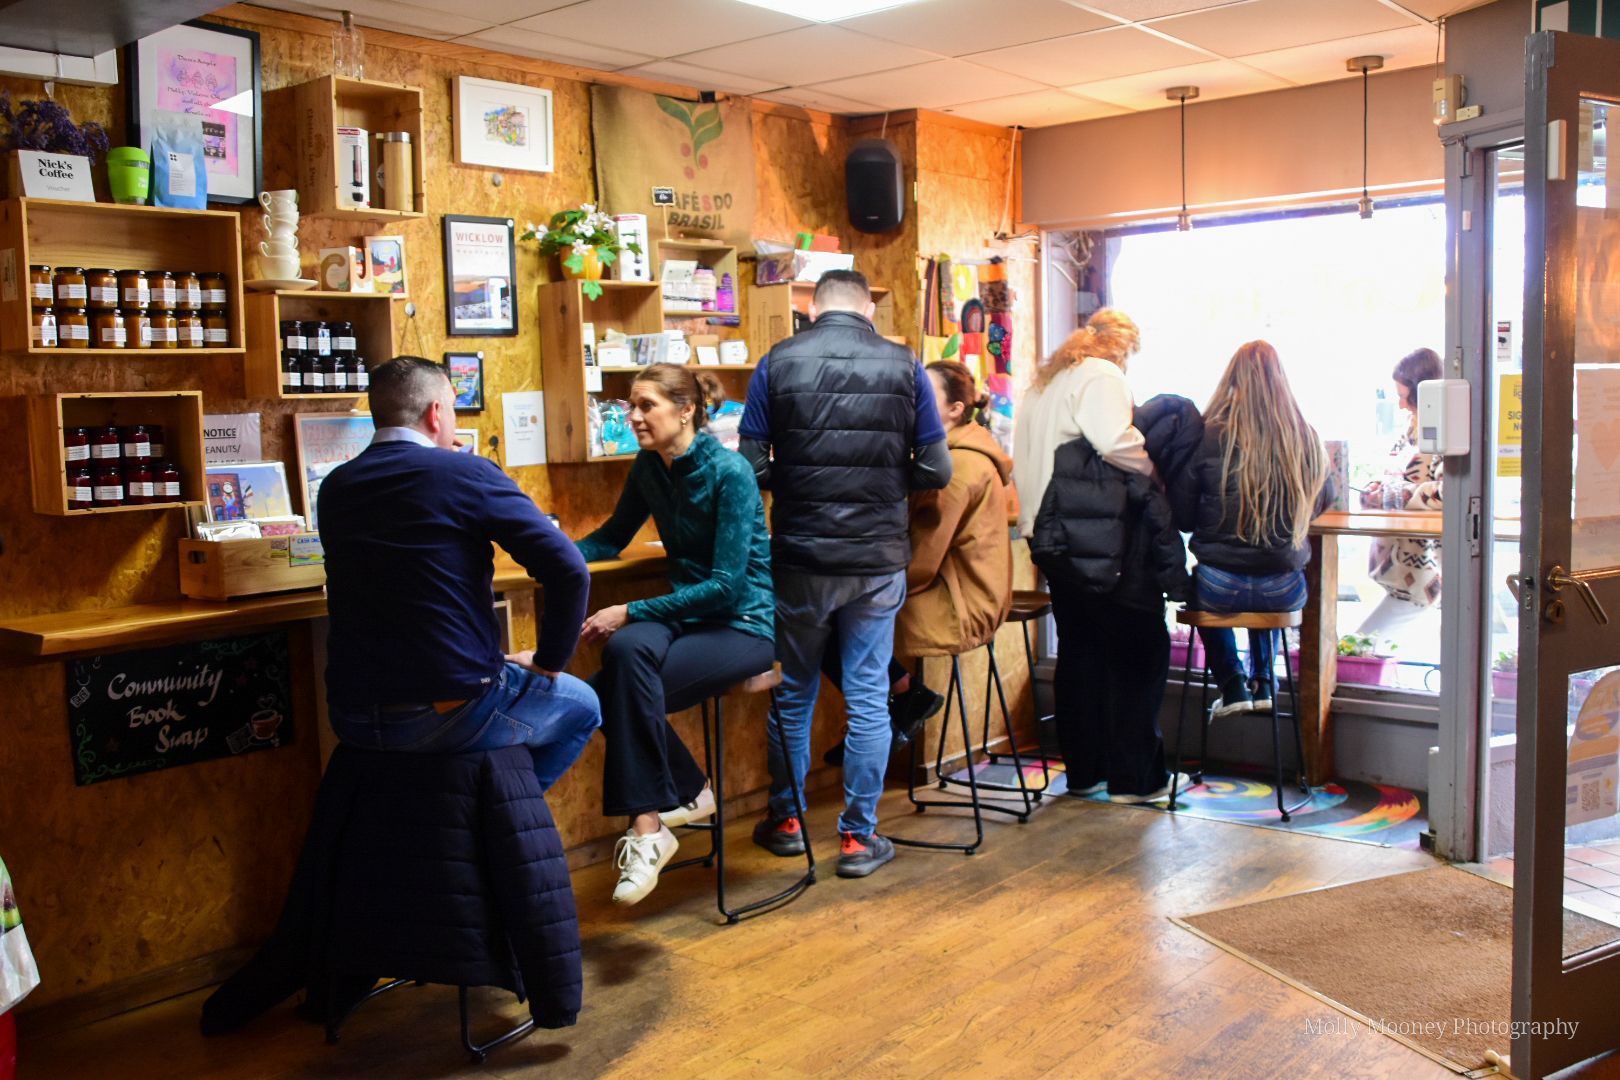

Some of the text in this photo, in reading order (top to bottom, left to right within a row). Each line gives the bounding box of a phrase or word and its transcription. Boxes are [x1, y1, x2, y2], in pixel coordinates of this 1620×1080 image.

[38, 158, 73, 170] Nick's
[39, 168, 74, 179] Coffee
[673, 191, 712, 212] AFÉS
[713, 192, 733, 210] DO
[668, 212, 725, 230] BRASIL
[455, 232, 504, 244] WICKLOW
[1507, 411, 1522, 420] SIG
[203, 428, 237, 438] NOTICE
[205, 444, 241, 454] EANUTS/
[107, 663, 223, 707] Community
[126, 700, 186, 728] Book
[154, 725, 209, 753] Swap
